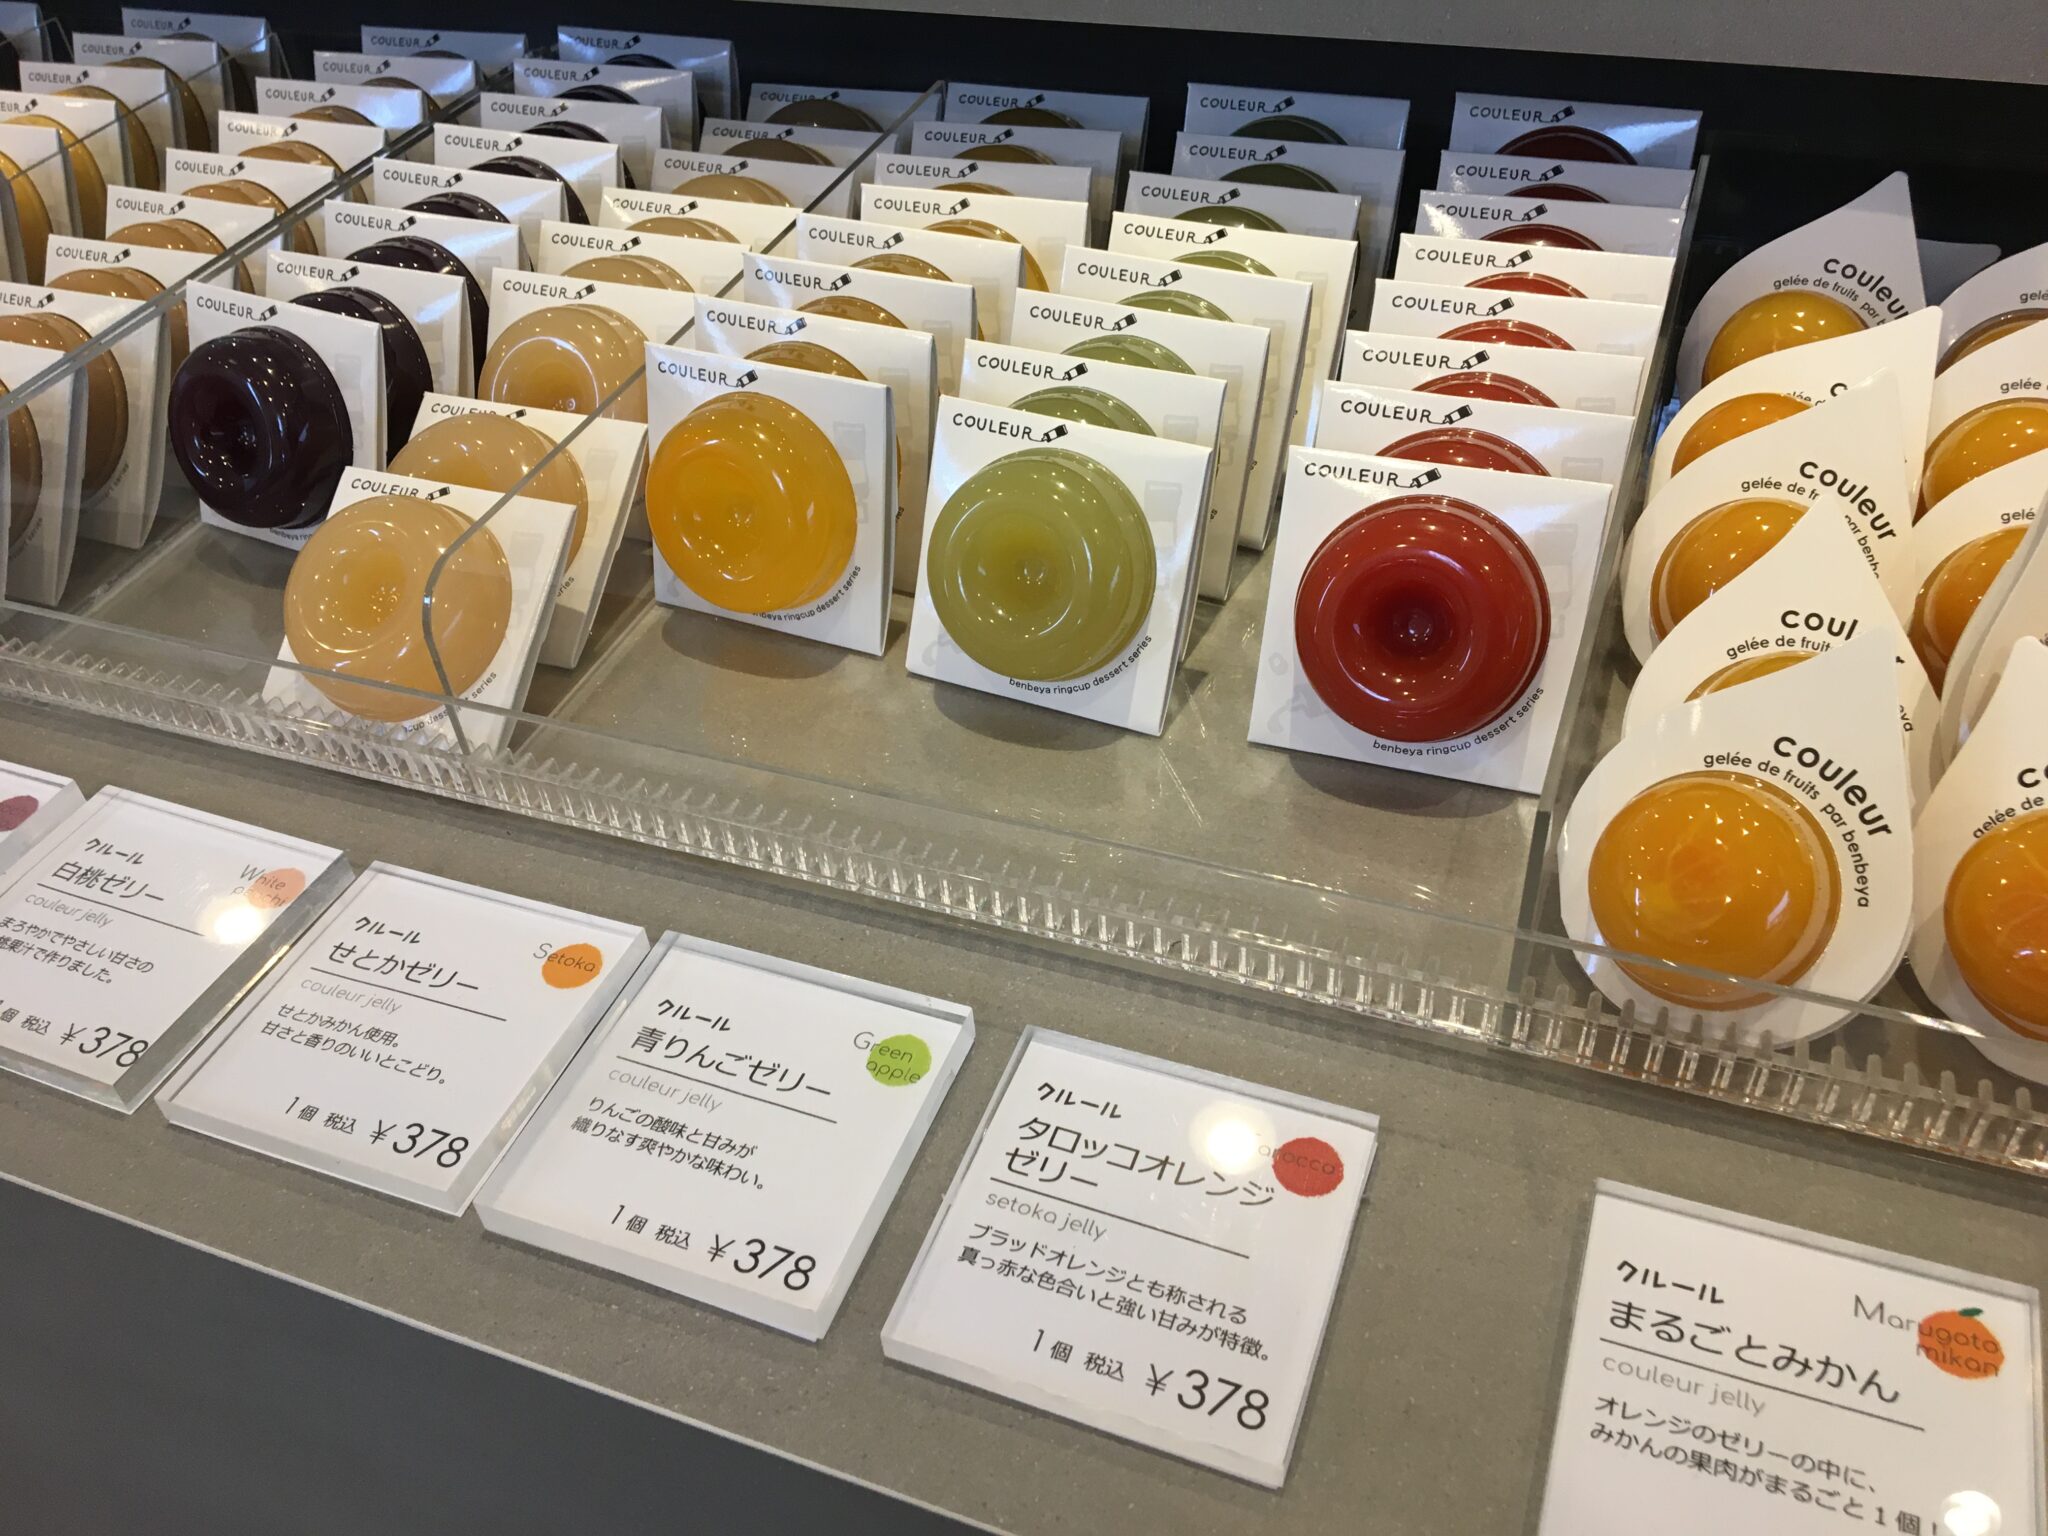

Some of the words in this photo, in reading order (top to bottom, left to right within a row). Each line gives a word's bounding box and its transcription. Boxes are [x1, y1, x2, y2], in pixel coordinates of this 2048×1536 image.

[131, 18, 173, 30] COULEUR
[81, 43, 124, 55] COULEUR
[371, 35, 420, 48] COULEUR
[28, 71, 72, 84] COULEUR
[322, 61, 370, 75] COULEUR
[523, 67, 577, 81] COULEUR
[265, 88, 314, 102] COULEUR
[959, 94, 1018, 108] COULEUR
[1200, 97, 1266, 112] COULEUR
[491, 101, 545, 116] COULEUR
[1469, 105, 1542, 123] COULEUR
[445, 135, 500, 151] COULEUR
[712, 126, 769, 140] COULEUR
[924, 130, 987, 144] COULEUR
[1189, 145, 1257, 161] COULEUR
[175, 160, 223, 175] COULEUR
[383, 169, 439, 187] COULEUR
[664, 158, 723, 175] COULEUR
[886, 163, 951, 178] COULEUR
[1455, 164, 1532, 181] COULEUR
[116, 198, 164, 214] COULEUR
[612, 198, 672, 214] COULEUR
[874, 197, 941, 214] COULEUR
[1141, 185, 1210, 203] COULEUR
[335, 212, 392, 230] COULEUR
[1124, 223, 1197, 243] COULEUR
[551, 233, 614, 251] COULEUR
[809, 227, 875, 249] COULEUR
[55, 246, 108, 262] COULEUR
[1414, 248, 1497, 268] COULEUR
[277, 262, 334, 281] COULEUR
[755, 268, 821, 290] COULEUR
[1077, 262, 1151, 286] COULEUR
[503, 279, 567, 299] COULEUR
[1773, 274, 1809, 290] gelée
[1813, 277, 1830, 289] de
[1832, 281, 1860, 302] fruits
[1860, 302, 1880, 320] par
[197, 296, 252, 319] COULEUR
[1030, 305, 1104, 330] COULEUR
[1391, 295, 1477, 316] COULEUR
[707, 309, 776, 334] COULEUR
[977, 355, 1054, 379] COULEUR
[1362, 349, 1451, 369] COULEUR
[658, 361, 728, 385] COULEUR
[2000, 377, 2042, 394] gelée
[1340, 400, 1431, 423] COULEUR
[953, 413, 1032, 439] COULEUR
[1304, 462, 1399, 487] COULEUR
[1741, 477, 1783, 492] gelée
[1787, 480, 1806, 496] de
[1799, 461, 1897, 541] couleur
[784, 609, 816, 622] ringcup
[815, 589, 845, 614] dessert
[843, 565, 862, 591] series
[1726, 636, 1770, 660] gelée
[1775, 635, 1796, 648] de
[1009, 677, 1051, 695] benbeya
[1053, 682, 1091, 695] ringcup
[1093, 661, 1129, 687] dessert
[1128, 635, 1152, 663] series
[471, 671, 497, 699] series
[1373, 739, 1424, 756] benbeya
[1426, 740, 1472, 756] ringcup
[1473, 716, 1518, 746] dessert
[1516, 687, 1545, 718] series
[1773, 736, 1893, 837] couleur
[2020, 794, 2046, 812] de
[1703, 751, 1752, 769] gelée
[1757, 760, 1781, 777] de
[1782, 771, 1820, 801] fruits
[1820, 802, 1848, 831] par
[1842, 829, 1870, 909] benbeya
[85, 837, 146, 866] クルール
[52, 860, 165, 902] 白桃ゼリー
[239, 863, 287, 891] White
[25, 891, 82, 917] couleur
[75, 908, 114, 929] jelly
[355, 916, 422, 946] クルール
[0, 916, 155, 974] まろやかでやさしい甘さの
[328, 942, 480, 992] せとかゼリー
[532, 942, 597, 975] Setoka
[301, 977, 366, 1006] couleur
[360, 990, 404, 1015] jelly
[277, 1002, 400, 1049] せとかみかん使用。
[657, 999, 732, 1033] クルール
[21, 1014, 52, 1036] 税込
[60, 1023, 149, 1069] ¥378
[260, 1019, 447, 1086] 甘さと香りのいいとこどり。
[852, 1031, 914, 1064] Green
[630, 1025, 832, 1097] 青りんごゼリー
[866, 1058, 922, 1087] apple
[608, 1067, 683, 1101] couleur
[677, 1084, 723, 1114] jelly
[1037, 1082, 1122, 1120] クルール
[323, 1112, 357, 1135] 税込
[370, 1119, 470, 1168] ¥378
[588, 1095, 758, 1160] りんごの酸味と甘みが
[570, 1115, 764, 1190] 織りなす爽やかな味わい。
[1017, 1116, 1276, 1206] タロッコオレンジ
[1257, 1143, 1336, 1176] arocco
[1005, 1146, 1098, 1189] ゼリー
[985, 1190, 1058, 1226] setoka
[1057, 1210, 1108, 1242] jelly
[654, 1223, 692, 1250] 税込
[707, 1233, 817, 1291] ¥378
[968, 1222, 1247, 1327] ブラッドオレンジとも称される
[1616, 1259, 1726, 1305] クルール
[957, 1245, 1270, 1362] 真っ赤な色合いと強い甘みが特徴。
[1853, 1294, 2000, 1355] Marugoto
[1609, 1299, 1901, 1405] まるごとみかん
[1915, 1341, 2000, 1378] mikan
[1083, 1351, 1125, 1382] 税込
[1145, 1362, 1270, 1431] ¥378
[1602, 1353, 1704, 1397] couleur
[1708, 1382, 1767, 1417] jelly
[1594, 1395, 1877, 1493] オレンジのゼリーの中に、
